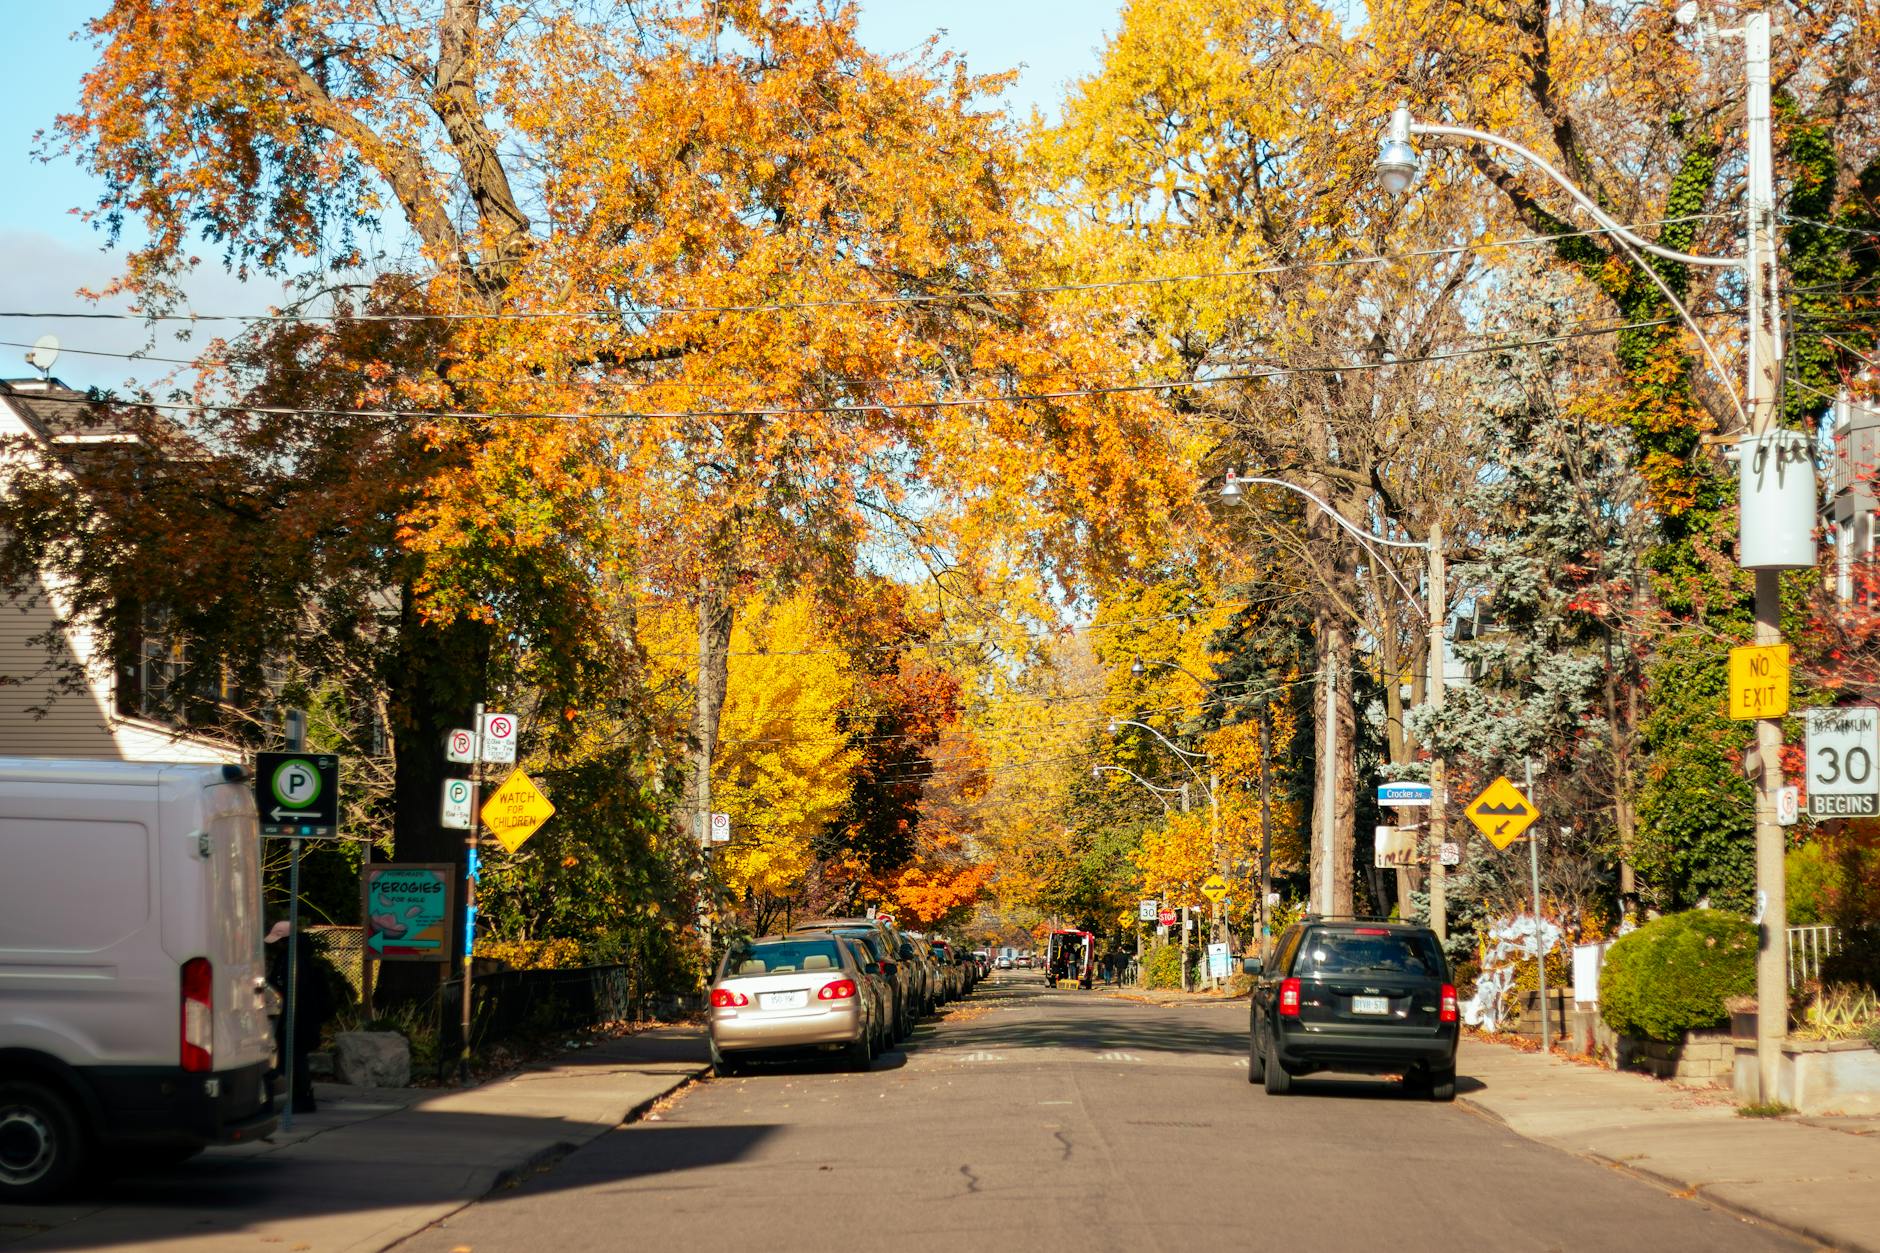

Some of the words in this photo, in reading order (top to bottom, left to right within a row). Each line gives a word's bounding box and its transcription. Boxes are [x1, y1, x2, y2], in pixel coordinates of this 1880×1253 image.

[1750, 656, 1770, 677] NO
[1743, 686, 1776, 708] EXIT
[1813, 718, 1873, 733] MAXIMUM
[1815, 746, 1872, 785] 30
[289, 773, 306, 794] P
[499, 791, 536, 804] WATCH
[1386, 789, 1413, 798] Crocker
[507, 805, 524, 815] FOR
[1814, 796, 1874, 814] BEGINS
[493, 815, 537, 829] CHILDREN
[371, 881, 442, 893] PEROGIES
[1142, 908, 1155, 918] 30
[1159, 912, 1177, 922] STOP
